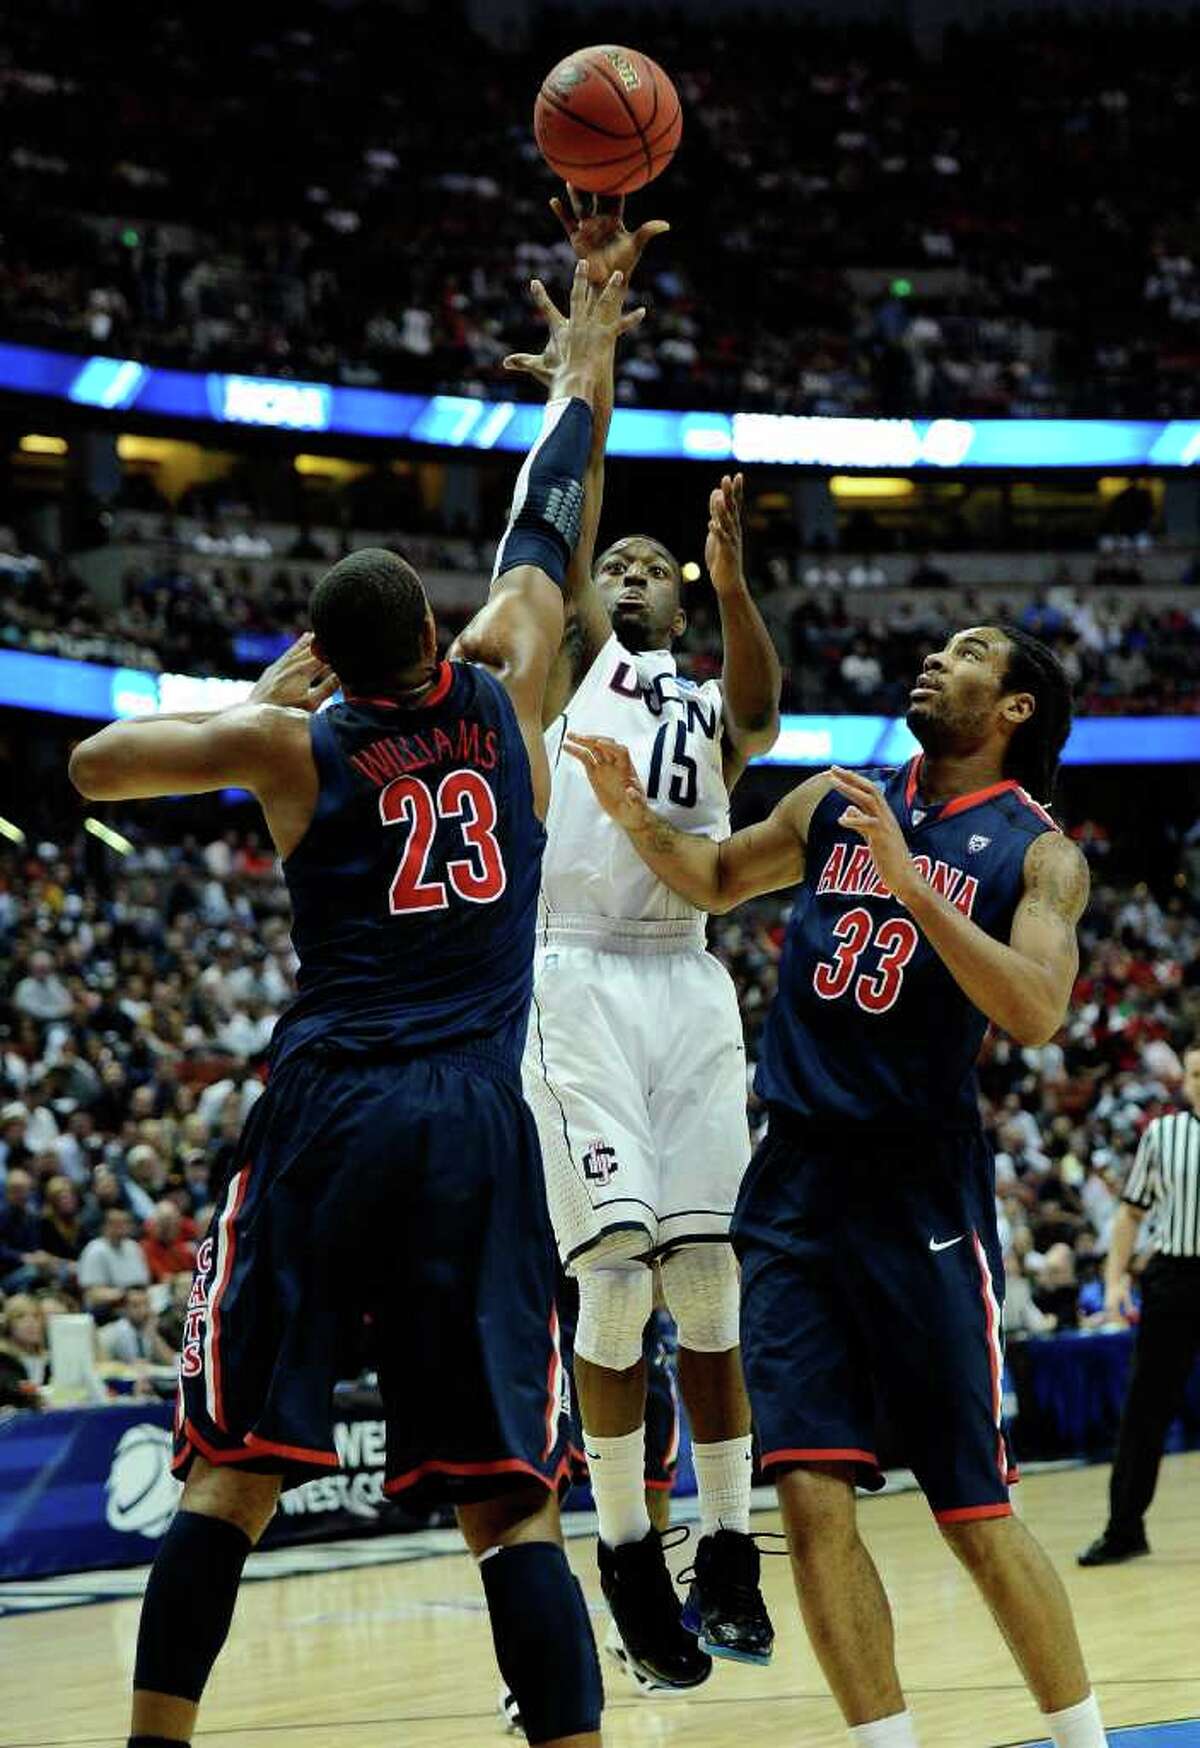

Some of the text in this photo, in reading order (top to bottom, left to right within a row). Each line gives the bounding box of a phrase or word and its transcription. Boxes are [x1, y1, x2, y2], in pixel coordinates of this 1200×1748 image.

[610, 662, 716, 740] UCON
[349, 718, 500, 787] WILLIAMS
[647, 720, 697, 808] 15
[379, 769, 507, 915] 23
[814, 907, 918, 1014] 33
[182, 1237, 213, 1377] CATS
